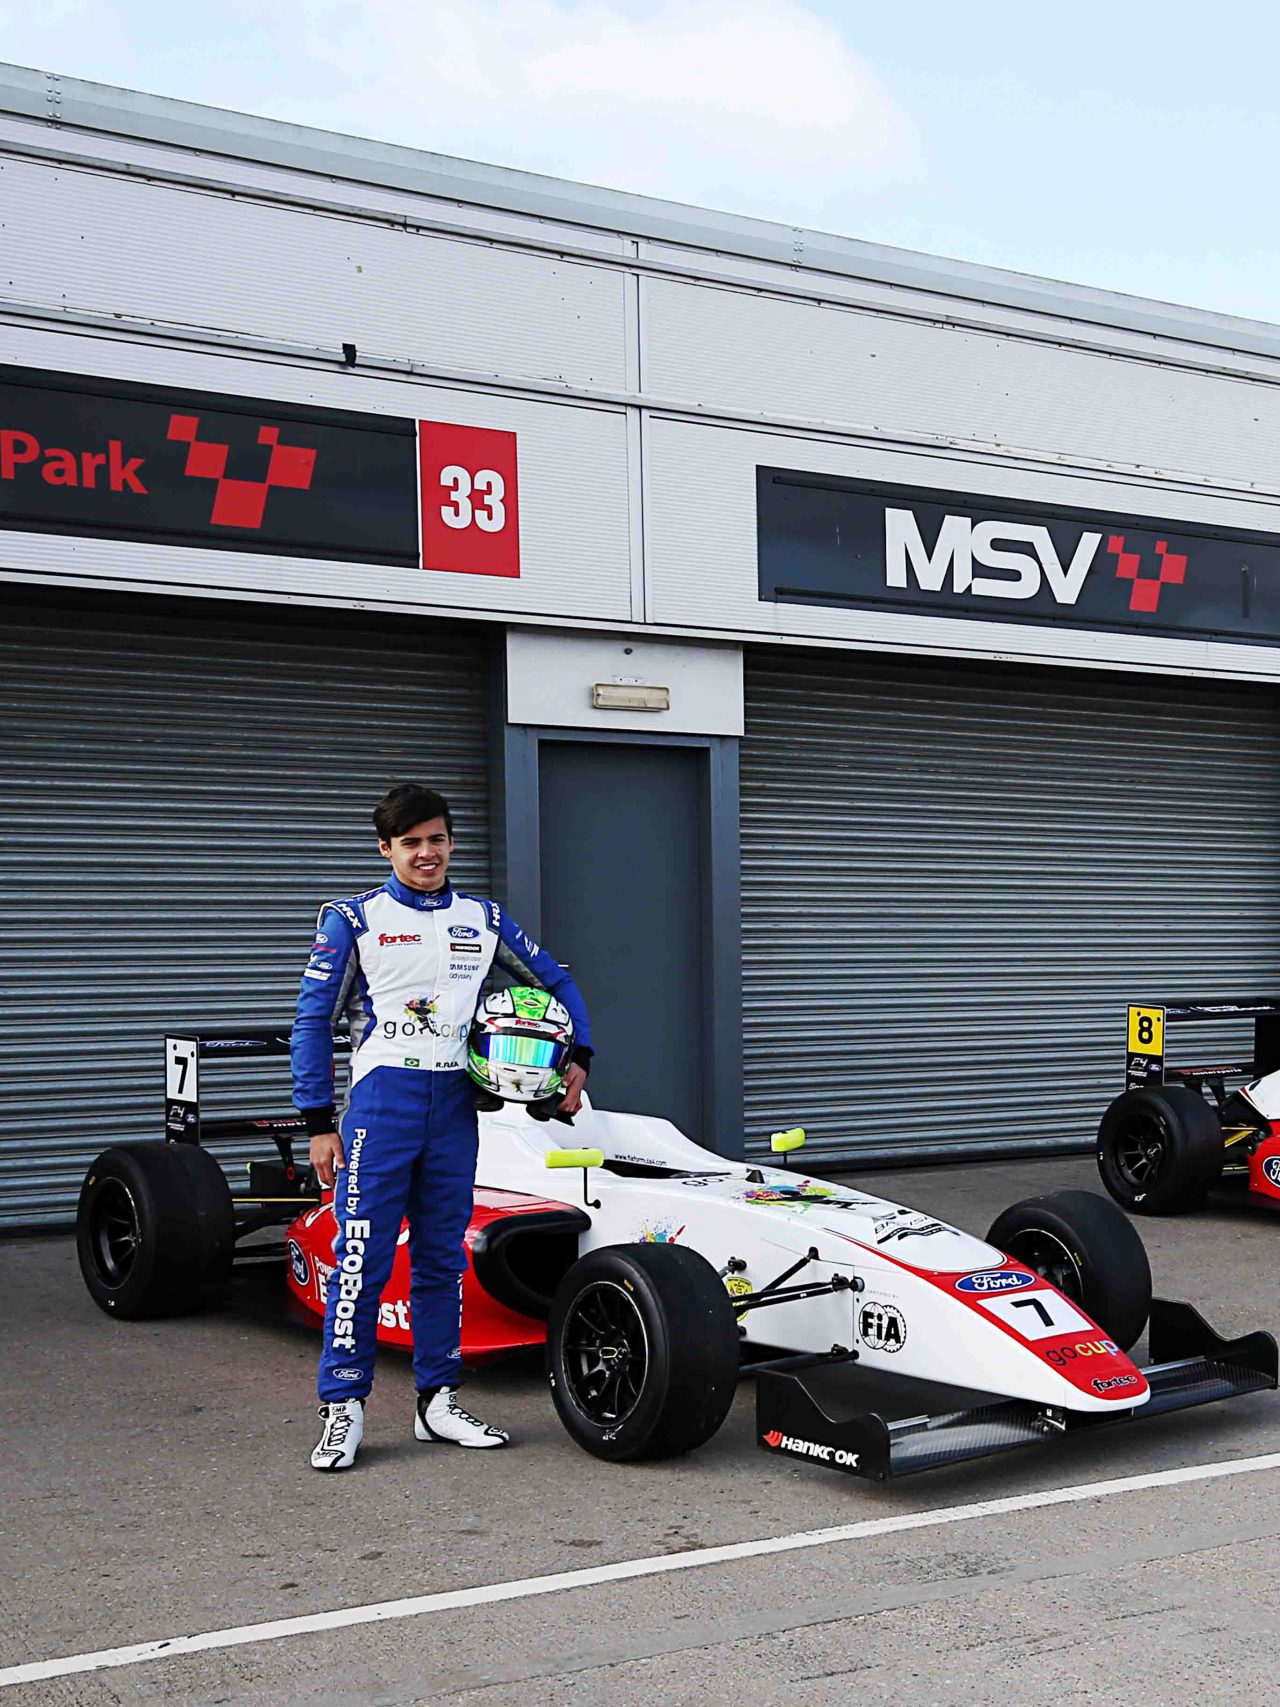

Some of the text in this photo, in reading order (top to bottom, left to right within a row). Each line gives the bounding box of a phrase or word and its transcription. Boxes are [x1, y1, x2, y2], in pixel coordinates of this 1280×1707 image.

[439, 465, 506, 533] 33
[884, 507, 1102, 605] MSV
[378, 933, 422, 947] fortec
[451, 927, 475, 938] Ford
[1138, 1016, 1153, 1045] 8
[174, 1056, 189, 1094] 7
[348, 1128, 367, 1194] Powered
[345, 1196, 360, 1216] by
[971, 1273, 1022, 1290] Ford
[1010, 1298, 1055, 1327] 7
[1091, 1374, 1138, 1393] fortec
